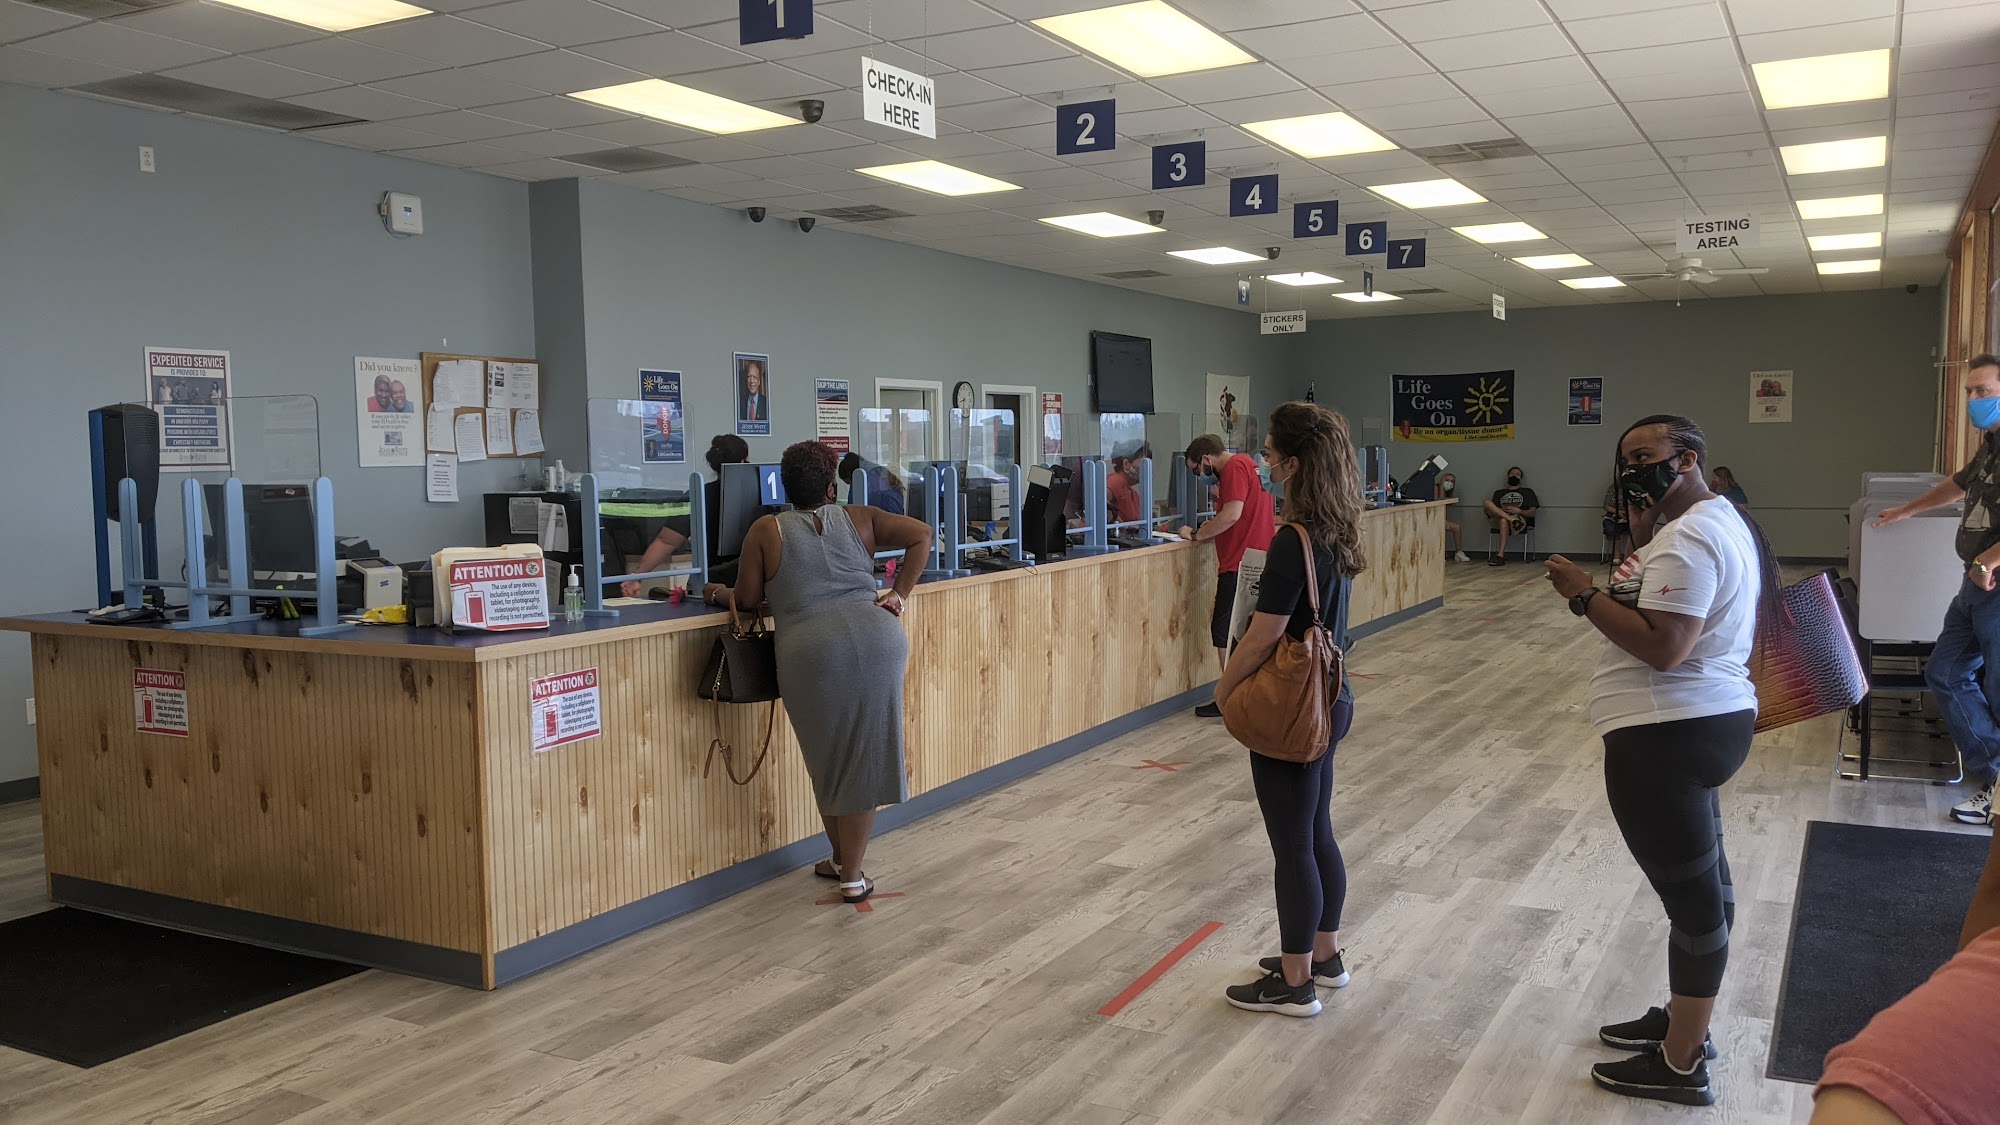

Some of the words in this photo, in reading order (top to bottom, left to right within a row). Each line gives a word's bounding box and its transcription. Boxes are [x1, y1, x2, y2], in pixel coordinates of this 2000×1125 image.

[868, 69, 932, 105] CHECK-IN
[884, 102, 920, 131] HERE
[1076, 113, 1096, 146] 2
[1169, 152, 1187, 182] 3
[1245, 184, 1262, 209] 4
[1308, 209, 1323, 232] 5
[1686, 218, 1750, 235] TESTING
[1359, 229, 1373, 250] 6
[1697, 235, 1739, 250] AREA
[1400, 245, 1412, 264] 7
[1241, 286, 1247, 301] 9
[1263, 314, 1304, 324] STICKERS
[1272, 324, 1295, 332] ONLY
[151, 354, 192, 367] EXPEDITED
[194, 356, 224, 368] SERVICE
[360, 360, 376, 371] Did
[377, 364, 391, 374] you
[393, 363, 417, 373] know?
[653, 375, 663, 384] Life
[817, 381, 827, 389] SKIP
[836, 382, 848, 390] LINES
[1397, 379, 1432, 394] Life
[1411, 395, 1453, 410] Goes
[661, 406, 669, 434] DONOR
[1430, 411, 1456, 426] On
[1436, 427, 1480, 436] organ/tissue
[767, 471, 777, 500] 1
[454, 563, 523, 581] ATTENTION
[136, 672, 175, 686] ATTENTION
[536, 675, 584, 696] ATTENTION
